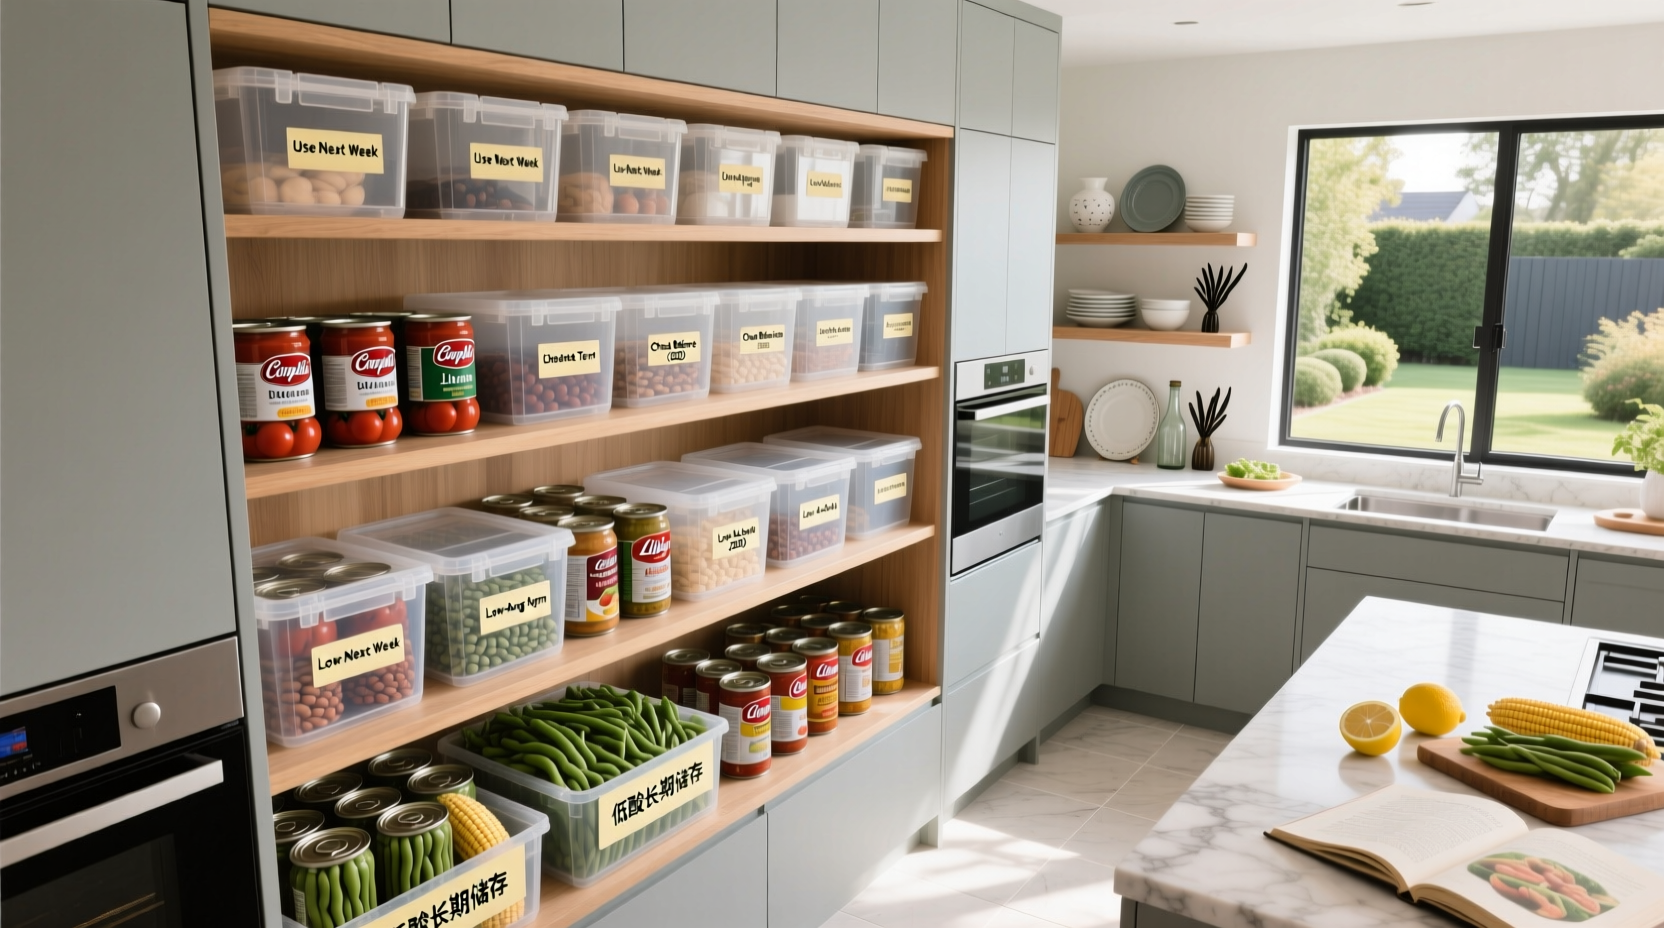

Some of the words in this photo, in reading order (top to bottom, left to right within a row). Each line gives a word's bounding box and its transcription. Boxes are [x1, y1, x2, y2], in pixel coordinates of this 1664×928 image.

[293, 140, 316, 153] Use
[318, 141, 346, 156] Next
[348, 143, 379, 158] Week
[474, 151, 492, 165] Use
[344, 648, 371, 663] Next
[372, 637, 400, 654] Week
[611, 761, 703, 827] 低酸长期储存
[392, 871, 508, 928] 酸长期储存
